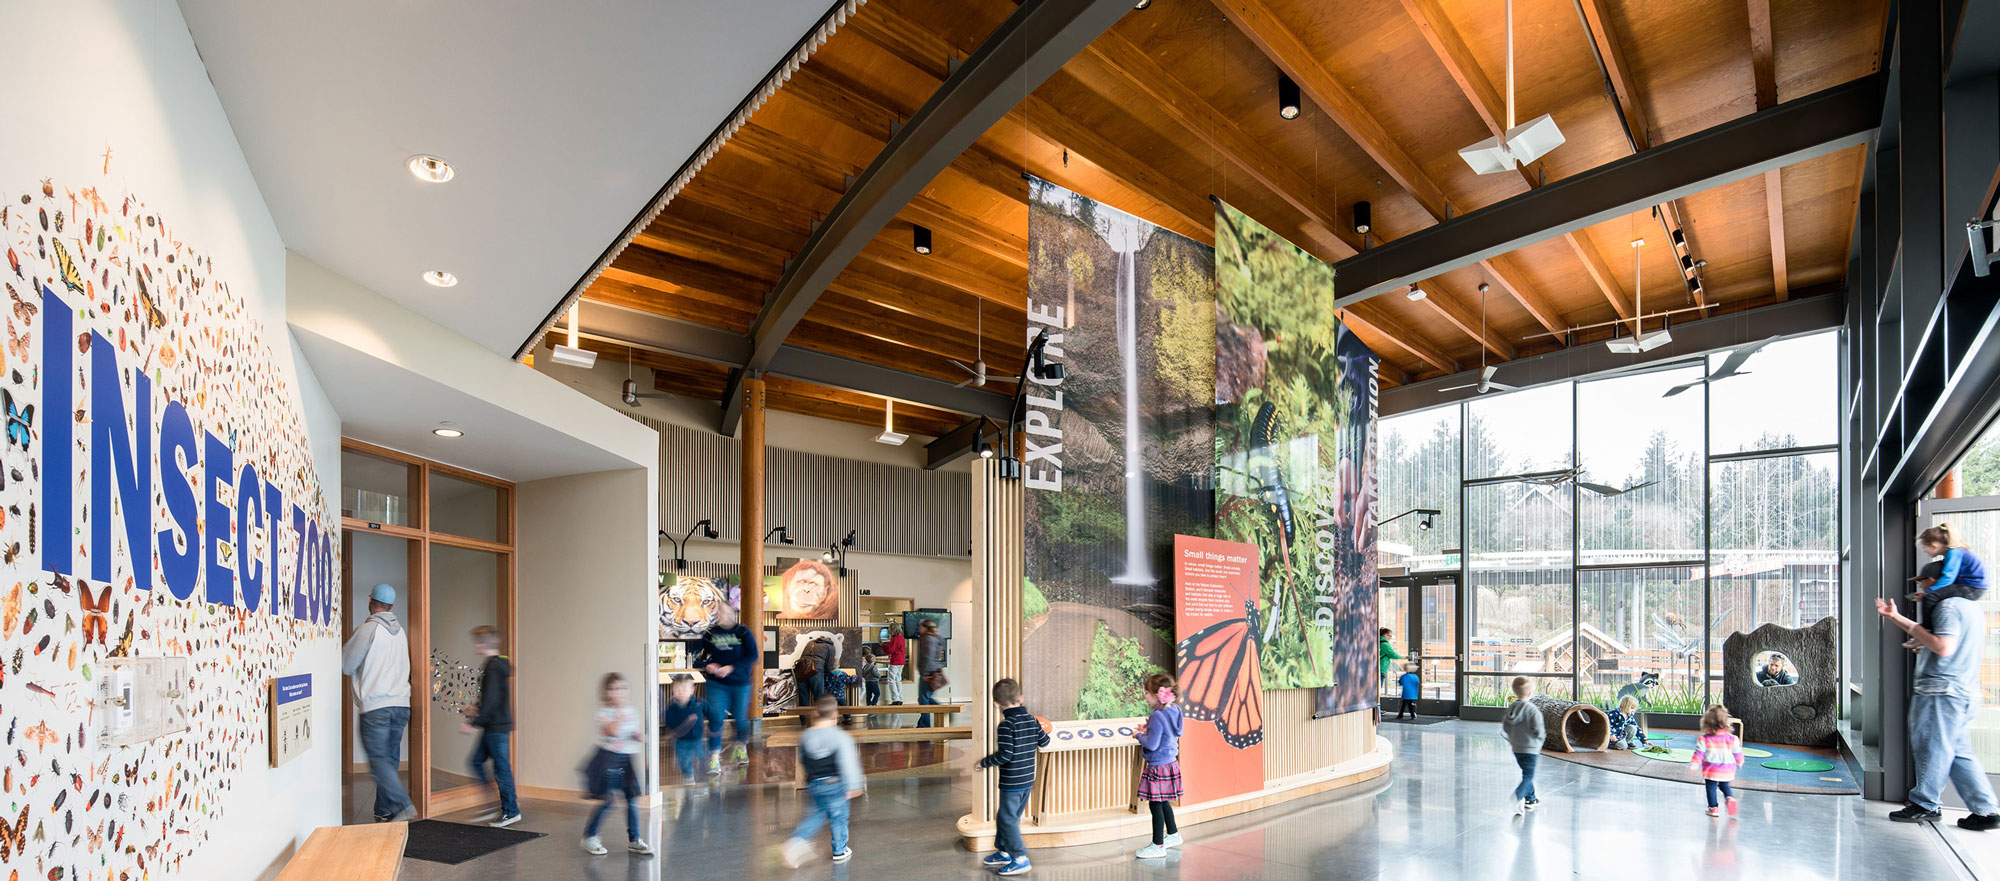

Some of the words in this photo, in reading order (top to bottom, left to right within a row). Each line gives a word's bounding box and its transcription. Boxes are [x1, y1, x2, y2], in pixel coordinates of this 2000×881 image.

[42, 284, 282, 616] INSECT
[293, 503, 332, 627] ZOO
[1368, 356, 1379, 461] ACTION
[1315, 467, 1334, 626] DISCOVER
[1367, 464, 1378, 529] TAKE
[1184, 549, 1204, 559] Small
[1205, 552, 1225, 563] things
[1226, 555, 1247, 564] matter
